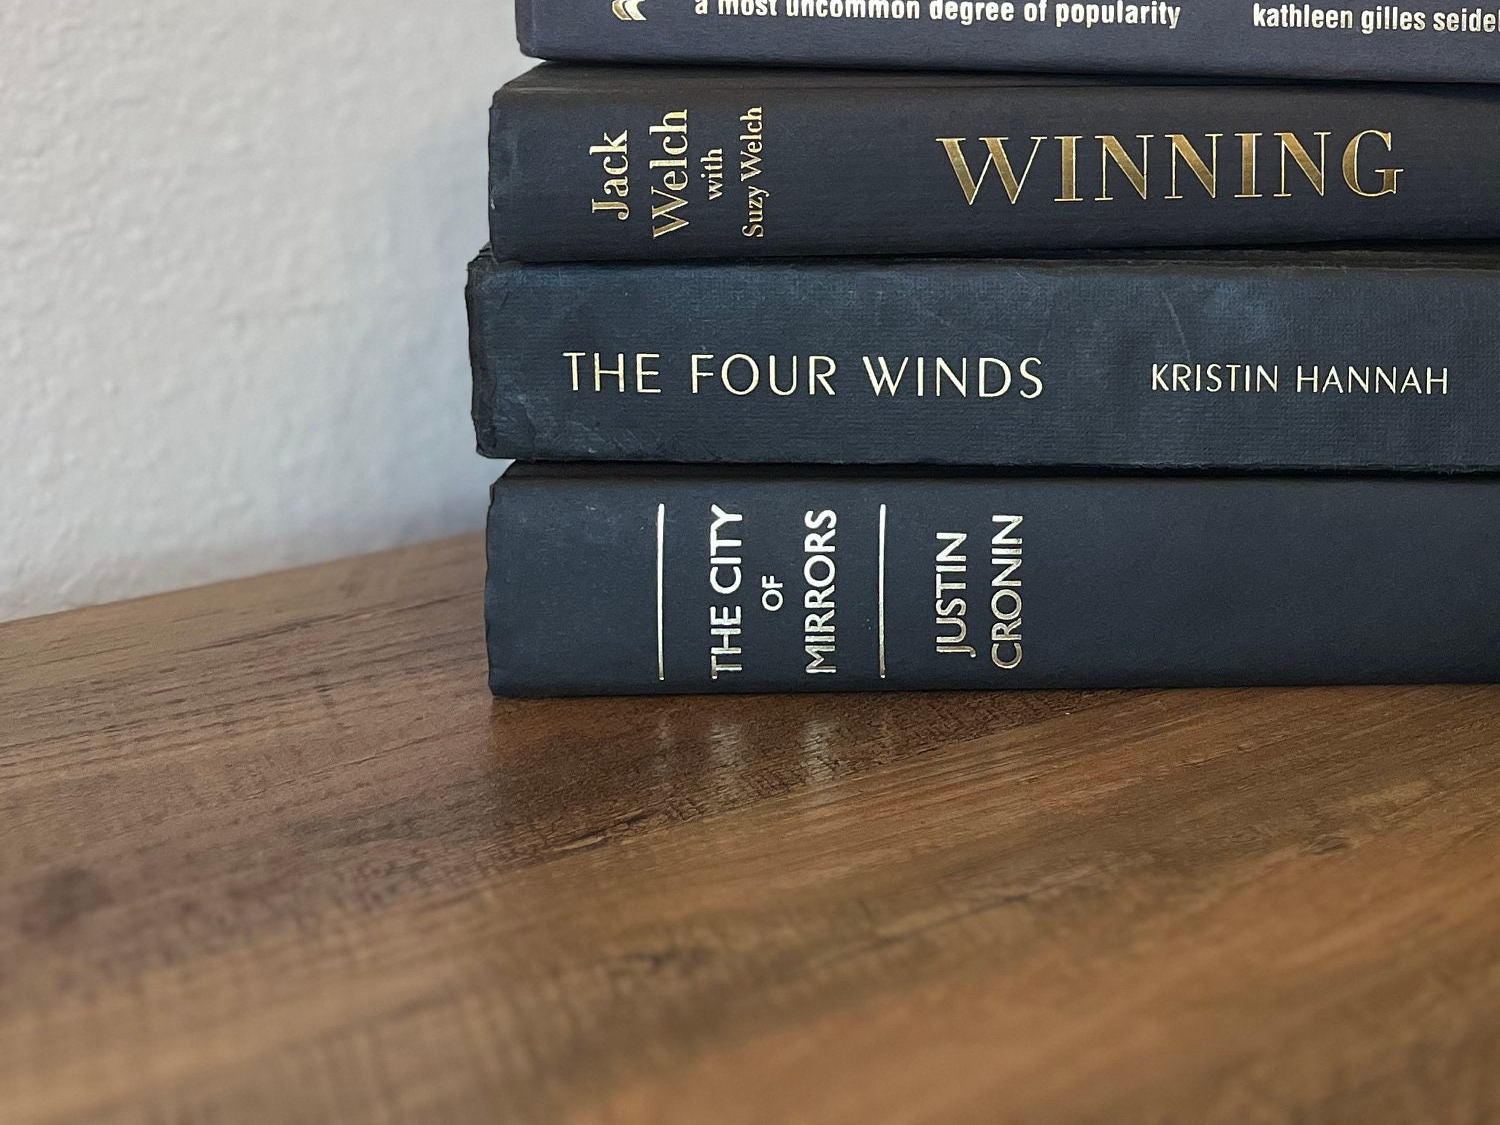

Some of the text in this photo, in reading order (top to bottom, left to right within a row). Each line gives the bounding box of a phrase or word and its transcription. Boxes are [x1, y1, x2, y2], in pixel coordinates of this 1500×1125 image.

[1055, 0, 1181, 30] popularity
[1253, 2, 1353, 29] kathleen
[1361, 5, 1426, 35] gilles
[588, 129, 630, 221] Jack
[648, 108, 690, 238] Welch
[699, 148, 723, 201] with
[739, 106, 770, 238] Suzy Welch
[935, 129, 1404, 206] WINNING
[562, 352, 1043, 399] THE FOUR WINDS
[1151, 363, 1448, 395] KRISTIN HANNAH
[709, 503, 743, 680] THE CITY
[761, 575, 784, 612] OF
[803, 509, 837, 674] MIRRORS
[935, 532, 977, 658] JUSTIN
[990, 514, 1024, 669] CRONIN
